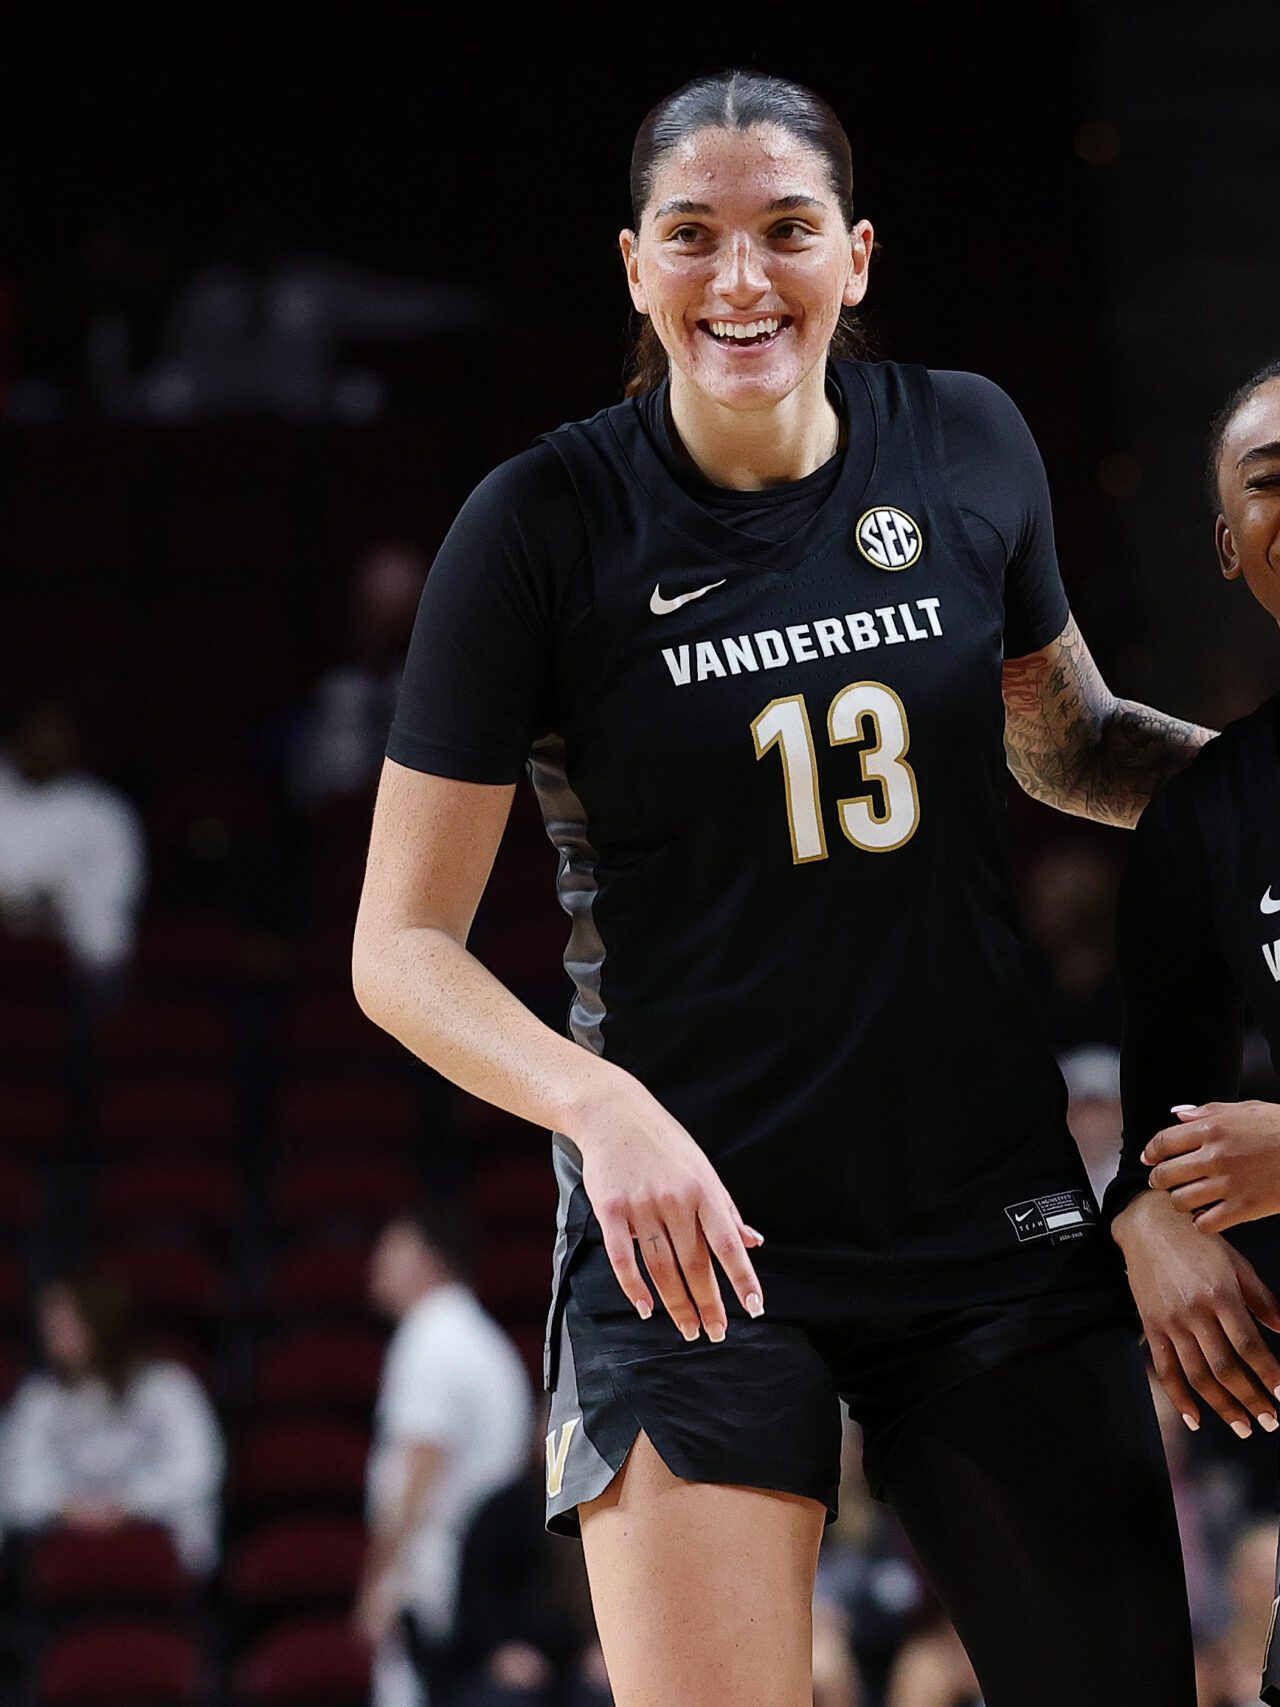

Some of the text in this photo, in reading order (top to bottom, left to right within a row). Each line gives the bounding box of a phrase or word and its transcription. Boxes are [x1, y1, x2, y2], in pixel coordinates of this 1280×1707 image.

[859, 510, 917, 567] SEC
[661, 597, 943, 687] VANDERBILT
[750, 681, 921, 865] 13
[1019, 1220, 1044, 1232] TEAM
